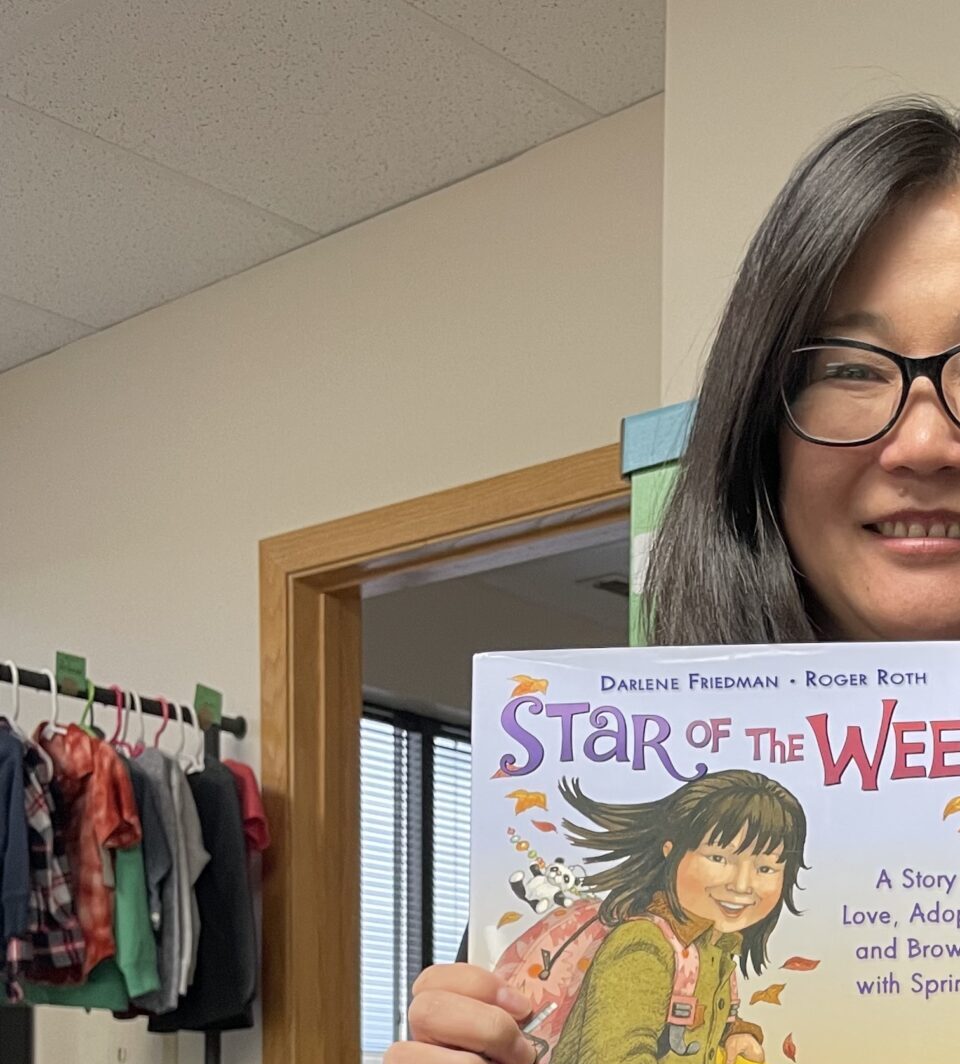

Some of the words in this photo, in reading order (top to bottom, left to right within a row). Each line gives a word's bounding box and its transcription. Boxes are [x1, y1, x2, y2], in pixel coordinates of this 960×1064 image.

[600, 675, 680, 691] DARLENE
[689, 672, 779, 689] FRIEDMAN
[805, 670, 868, 687] ROGER
[877, 668, 927, 686] ROTH
[686, 716, 732, 754] OF
[876, 869, 892, 889] A
[902, 868, 957, 894] Story
[843, 904, 898, 928] Love,
[856, 937, 897, 959] and
[856, 972, 900, 994] with
